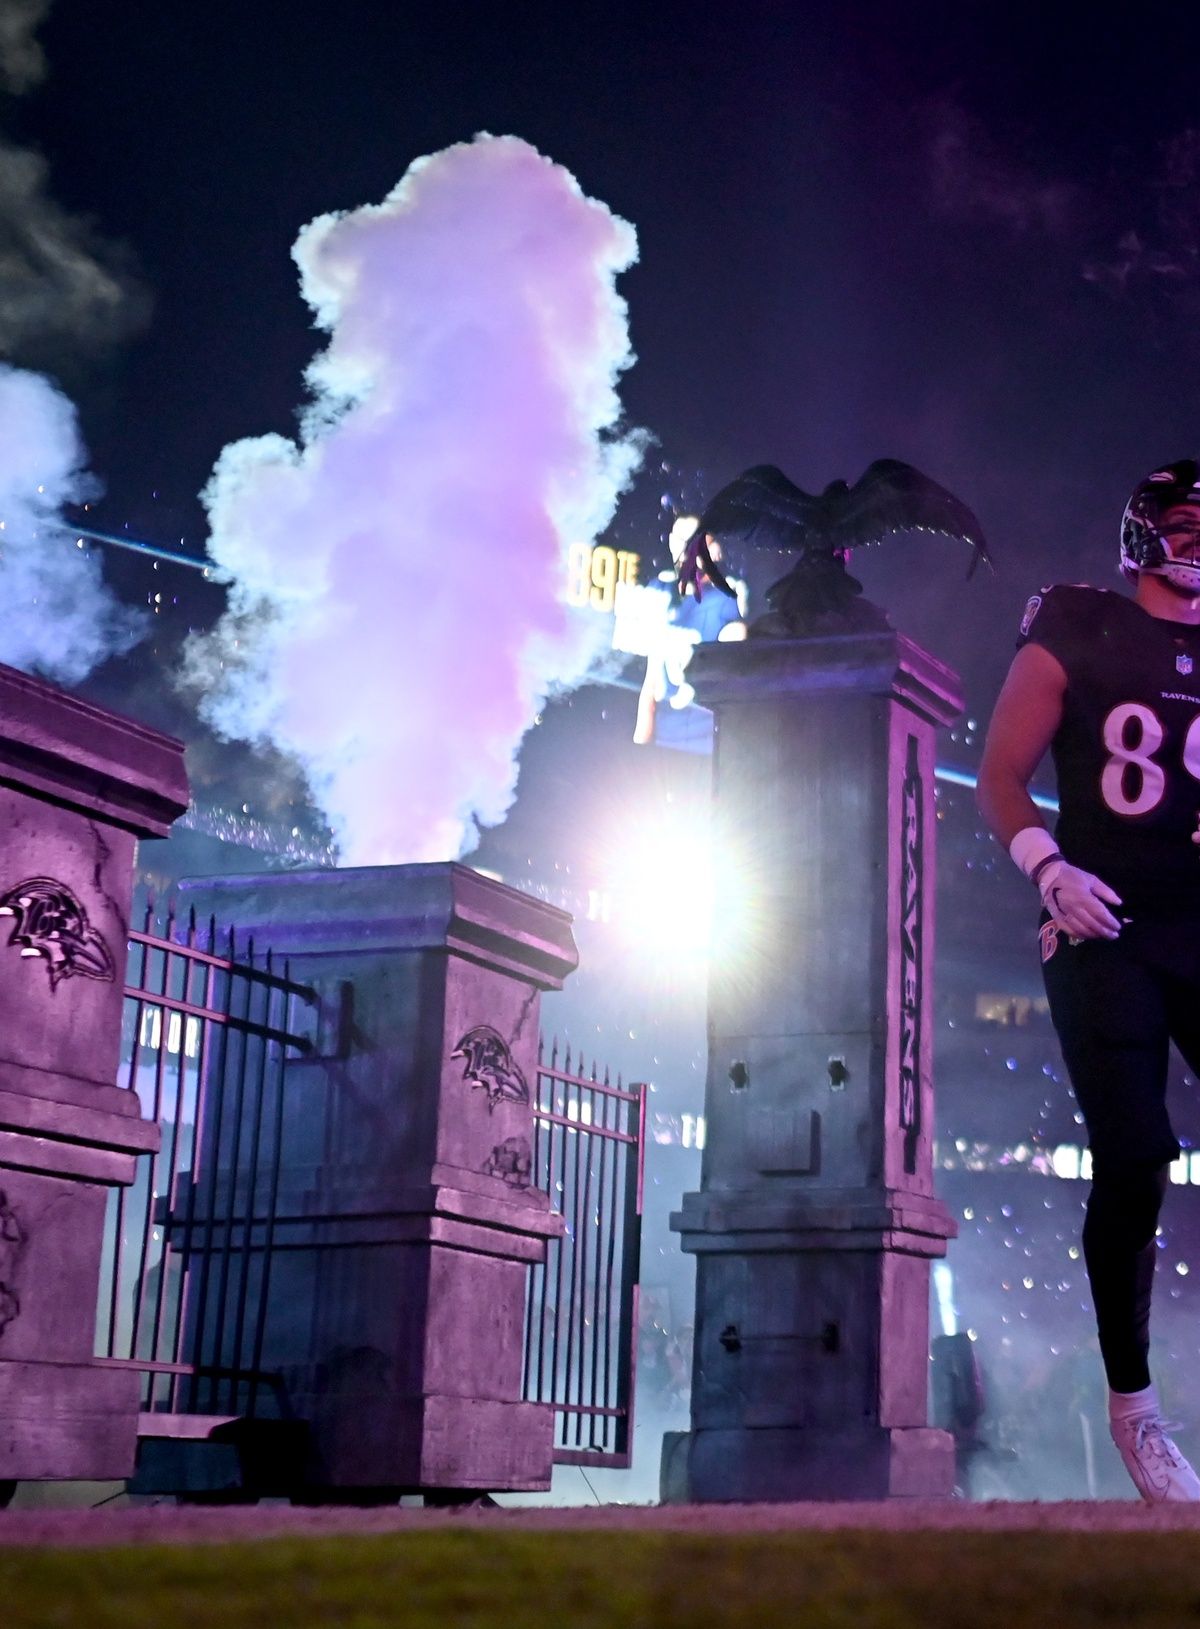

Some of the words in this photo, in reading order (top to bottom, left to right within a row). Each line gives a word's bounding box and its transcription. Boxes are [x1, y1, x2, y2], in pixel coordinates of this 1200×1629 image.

[567, 543, 617, 613] 89
[1160, 692, 1200, 704] RAVENS
[902, 779, 918, 1127] RAVENS
